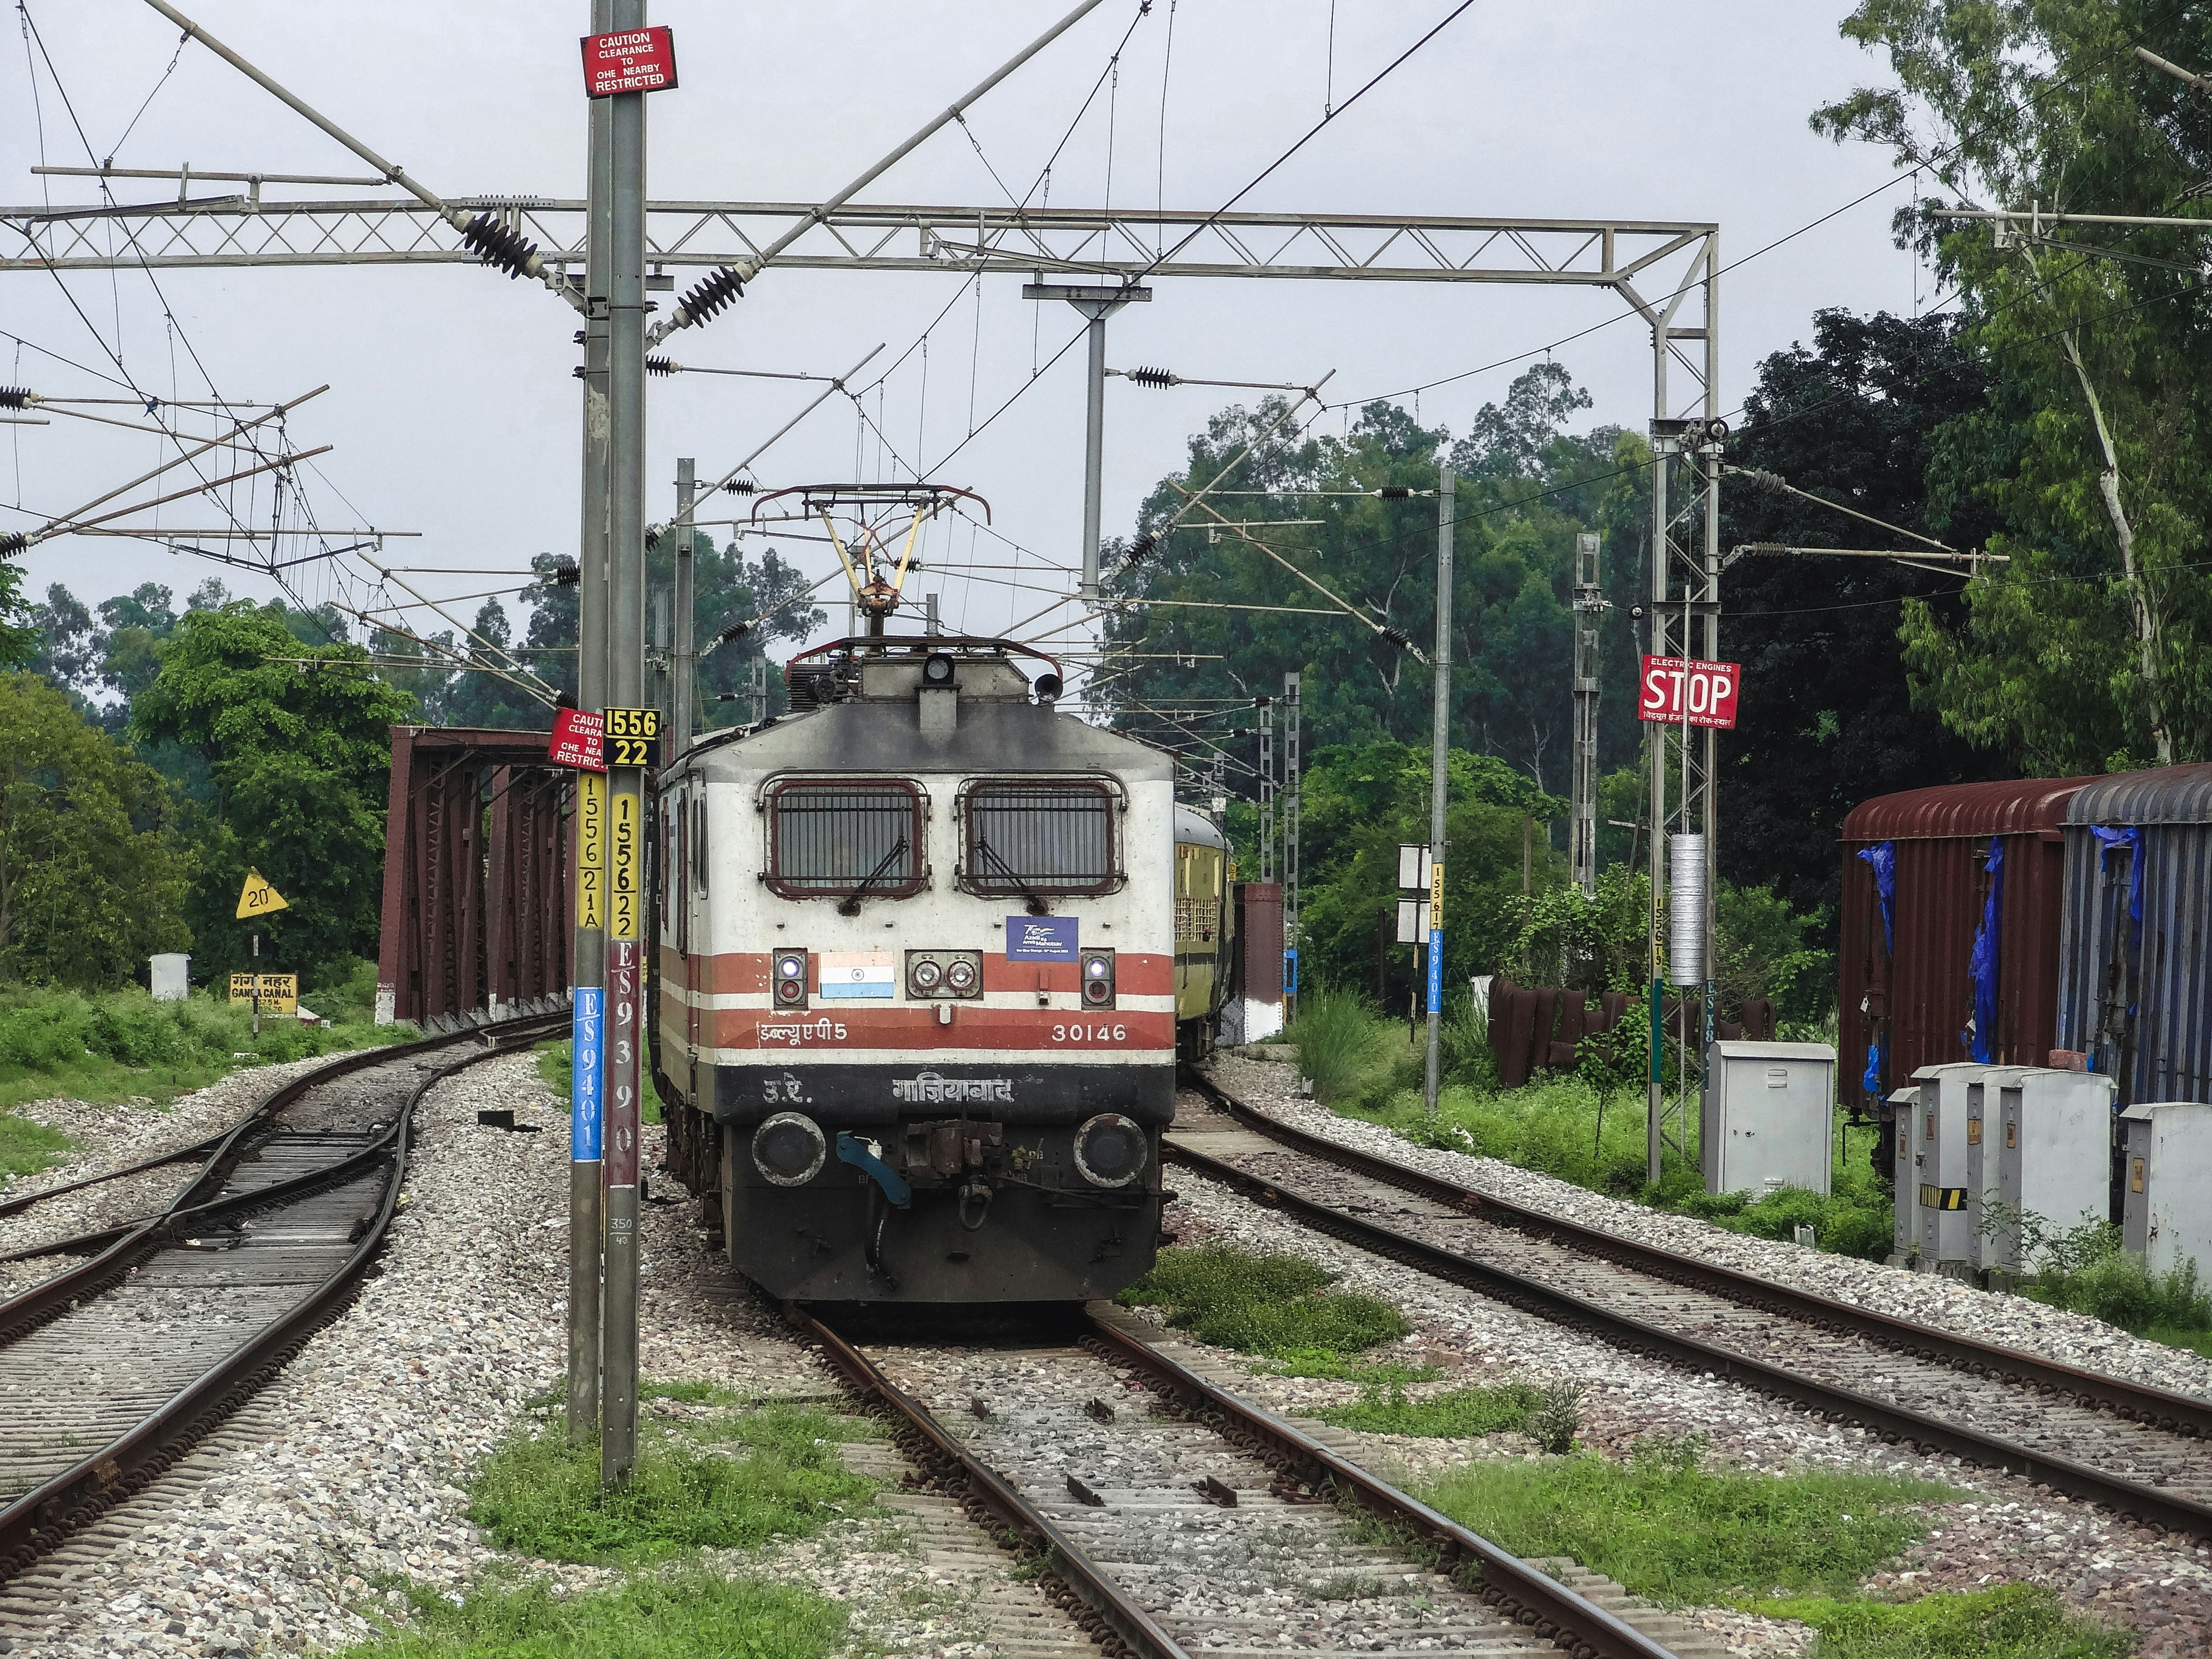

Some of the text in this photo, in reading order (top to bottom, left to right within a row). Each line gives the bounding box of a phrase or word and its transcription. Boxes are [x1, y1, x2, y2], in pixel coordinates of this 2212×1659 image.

[599, 32, 650, 48] CAUTION
[599, 44, 654, 59] CLEARANCE
[621, 57, 633, 66] TO
[597, 63, 660, 79] OHE NEARBY
[595, 74, 664, 92] RESTRICTED
[1651, 658, 1732, 672] ELECTRC ENGINES
[1644, 669, 1731, 715] STOP
[573, 714, 603, 728] CAUTI
[607, 710, 656, 736] 1556
[569, 725, 602, 737] CLEARA
[587, 737, 598, 745] TO
[585, 746, 601, 757] NEA
[615, 740, 647, 764] 22
[557, 750, 608, 769] RESTRIC
[248, 889, 269, 908] 20
[262, 976, 292, 988] नहर
[264, 989, 293, 998] CANAL
[1051, 1024, 1126, 1042] 30146
[611, 1218, 632, 1229] 350
